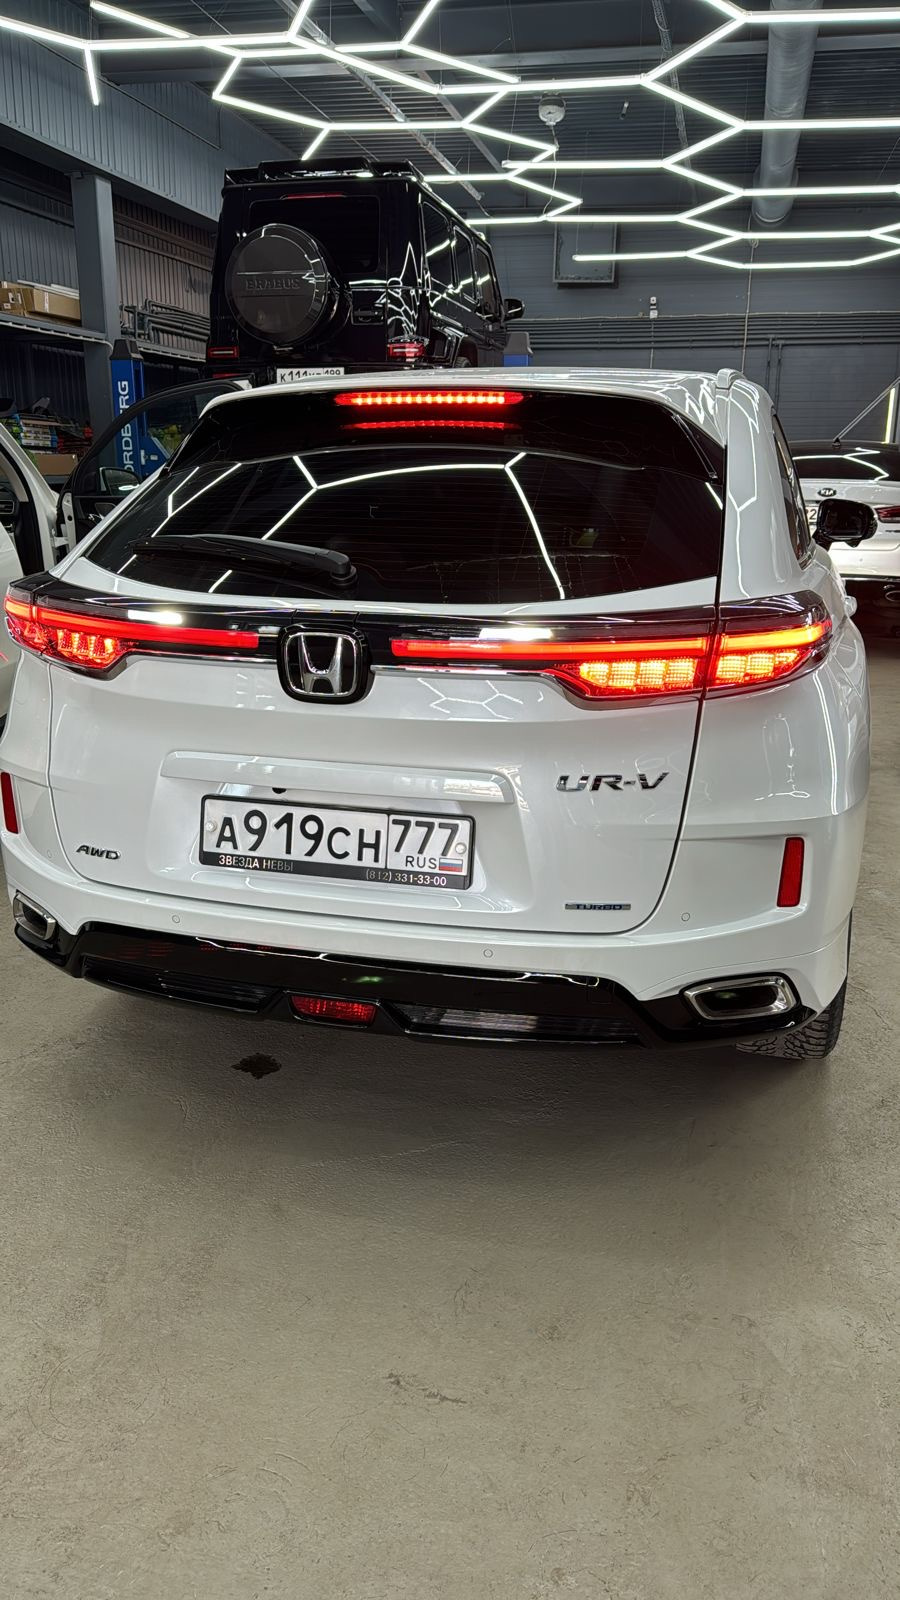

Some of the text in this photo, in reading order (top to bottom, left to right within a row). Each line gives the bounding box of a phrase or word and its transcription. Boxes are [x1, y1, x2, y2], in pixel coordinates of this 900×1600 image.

[245, 278, 301, 291] BRABUS
[820, 485, 835, 496] KIA
[556, 772, 669, 792] UR-V
[391, 818, 460, 857] 777
[76, 844, 121, 860] AWD
[218, 854, 294, 872] ЗВЕЗДА НЕВЫ
[405, 855, 437, 869] RUS
[365, 868, 447, 886] (812) 331-33-00
[576, 903, 623, 911] TURBO
